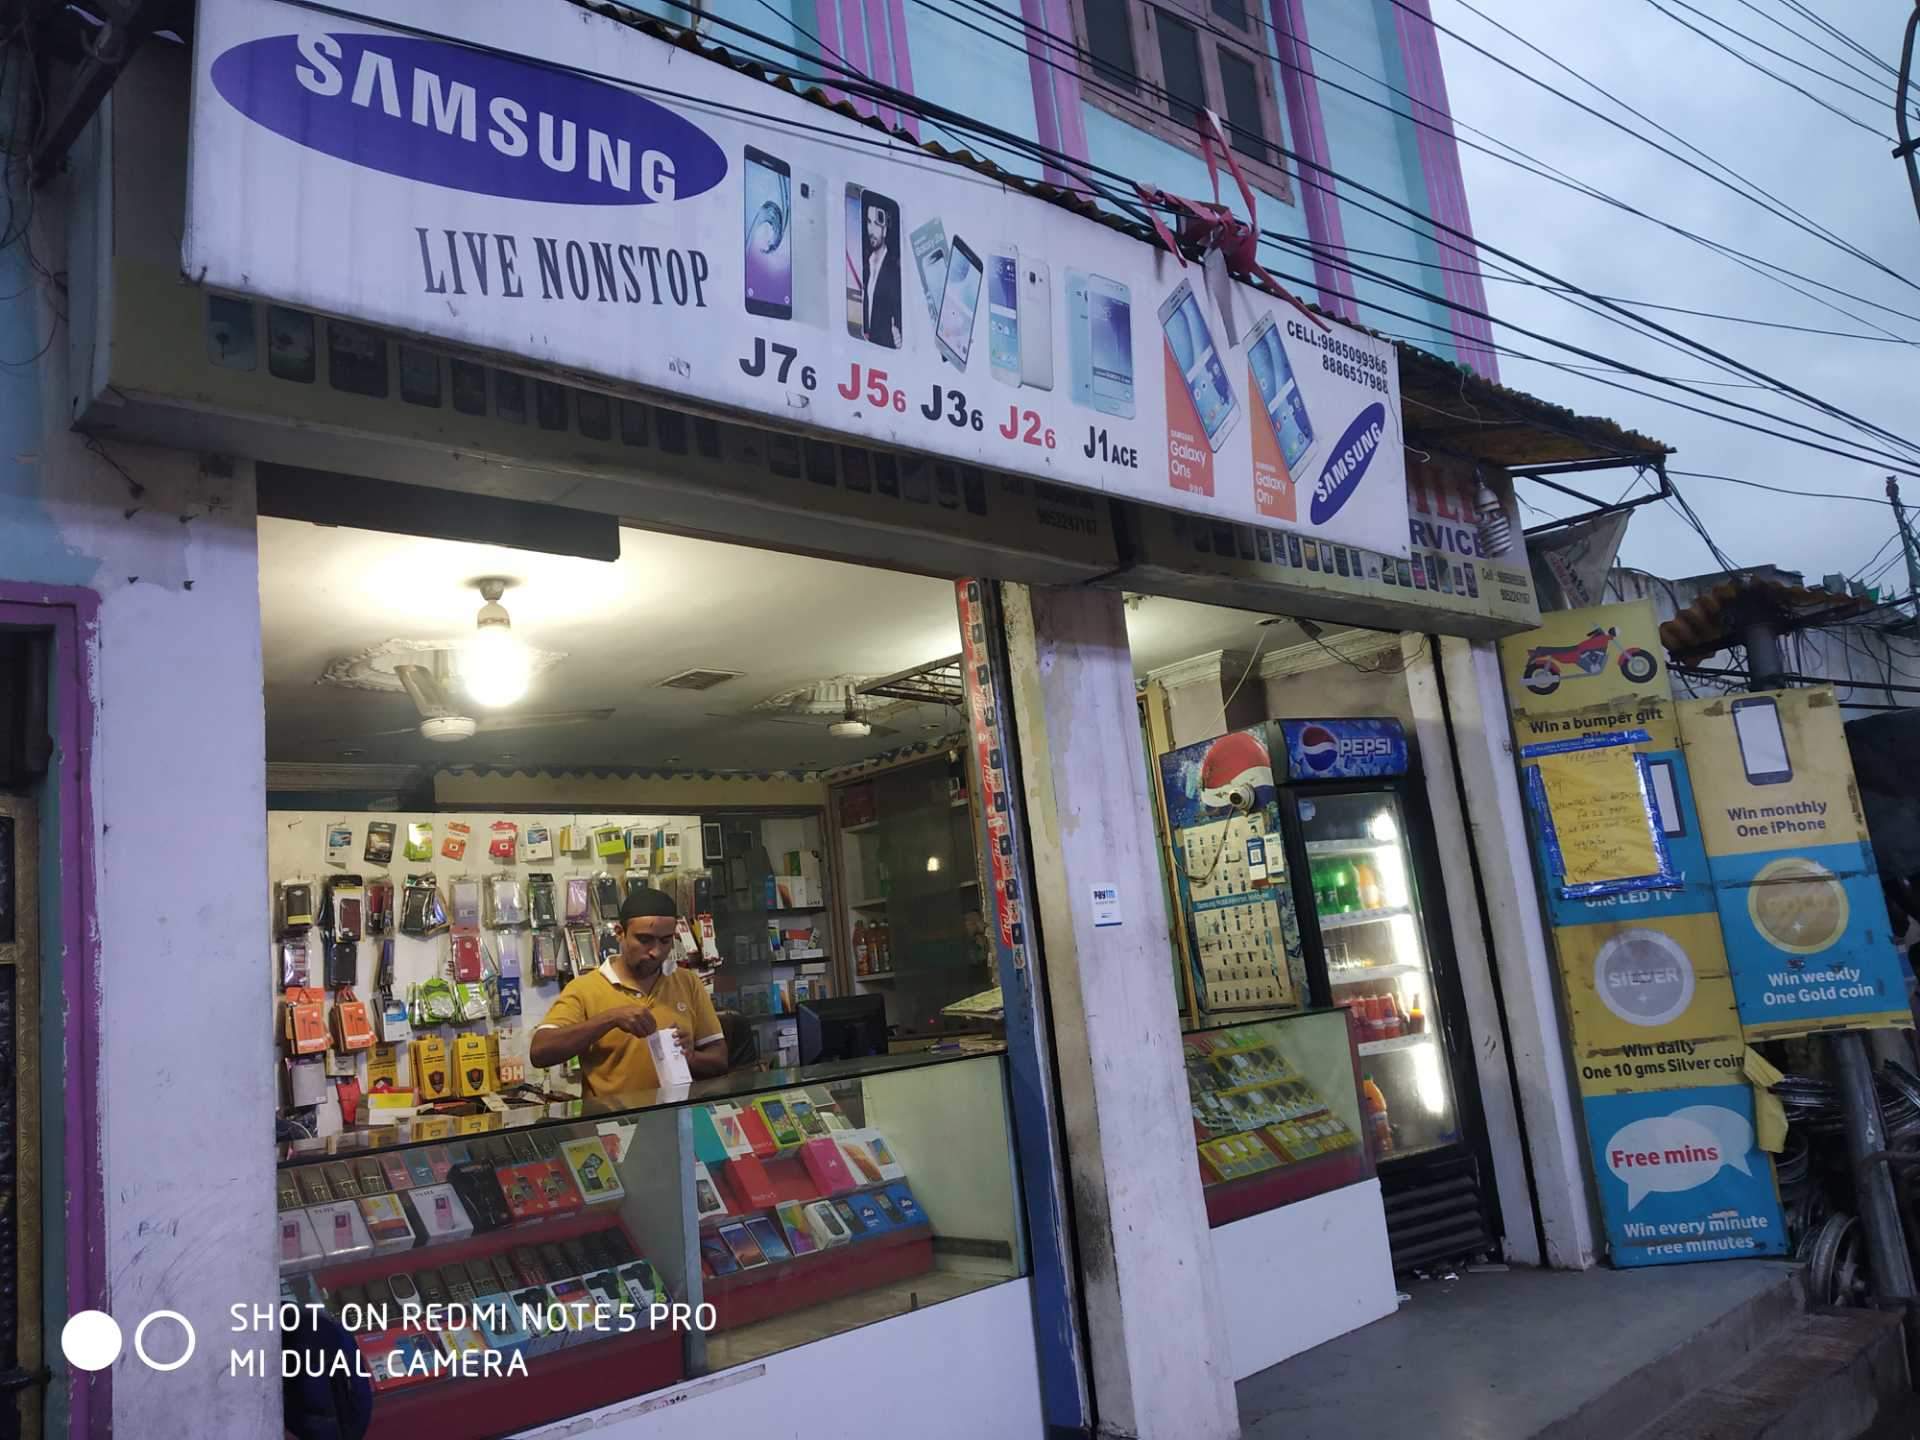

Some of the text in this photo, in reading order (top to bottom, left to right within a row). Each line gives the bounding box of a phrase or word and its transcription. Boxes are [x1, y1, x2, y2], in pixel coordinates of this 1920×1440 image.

[295, 31, 676, 202] SAMSUNG
[415, 227, 708, 307] LIVE NONSTOP
[1169, 440, 1208, 466] Galaxy
[1313, 422, 1382, 503] SAMSUNG
[1255, 471, 1288, 495] Galaxy
[1530, 708, 1664, 734] Win a bumper gift
[1340, 737, 1392, 756] PEPSI
[1728, 800, 1828, 822] Win monthly
[1737, 818, 1826, 838] One iPhone
[1619, 890, 1651, 905] LED
[1608, 966, 1680, 989] SILVER
[1768, 967, 1861, 987] Win weekly
[1763, 984, 1875, 1006] One Gold coin
[1622, 1039, 1696, 1059] Win daily
[1583, 1054, 1745, 1080] One 10 gms Silver coin
[1611, 1144, 1719, 1169] Free mins
[1624, 1214, 1769, 1239] Win every minute
[1686, 1235, 1756, 1253] minutes
